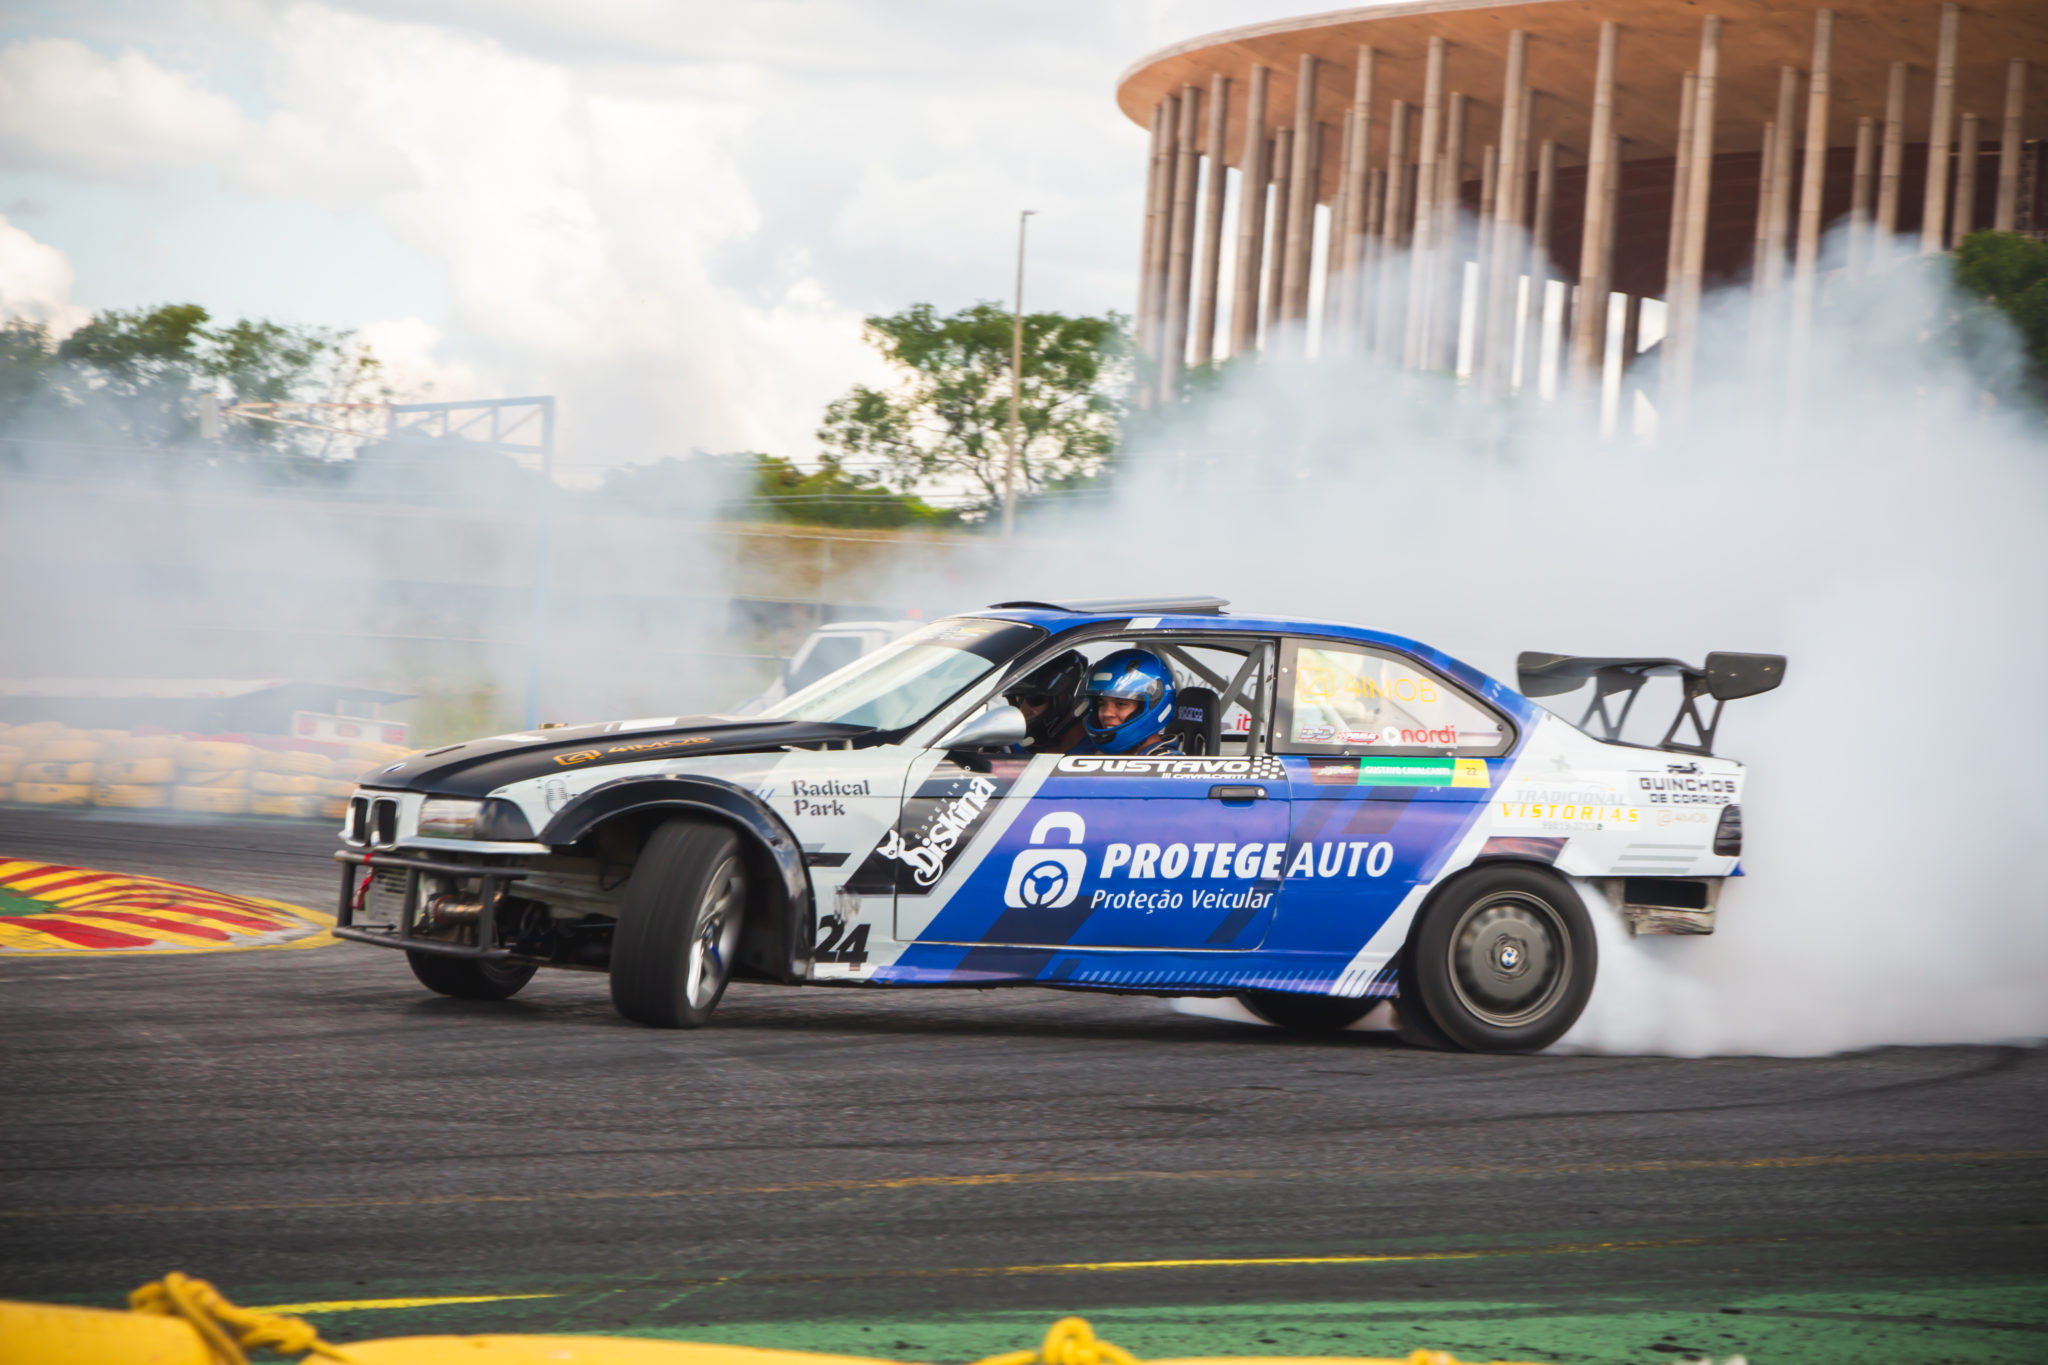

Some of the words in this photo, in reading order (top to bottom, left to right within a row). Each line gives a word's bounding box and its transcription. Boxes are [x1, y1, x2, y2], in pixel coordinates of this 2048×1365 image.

[1343, 673, 1438, 703] 4IMOB
[1401, 725, 1458, 744] nordi
[1057, 755, 1251, 773] GUSTAVO
[792, 779, 870, 796] Radical
[1640, 777, 1735, 793] GUINCHOS
[1516, 789, 1625, 806] TRADICIONAL
[1650, 793, 1667, 803] DE
[793, 799, 846, 816] Park
[1502, 802, 1640, 823] VISTORIAS
[1090, 889, 1183, 914] Proteção
[1192, 887, 1274, 909] Veicular
[815, 914, 871, 963] 24
